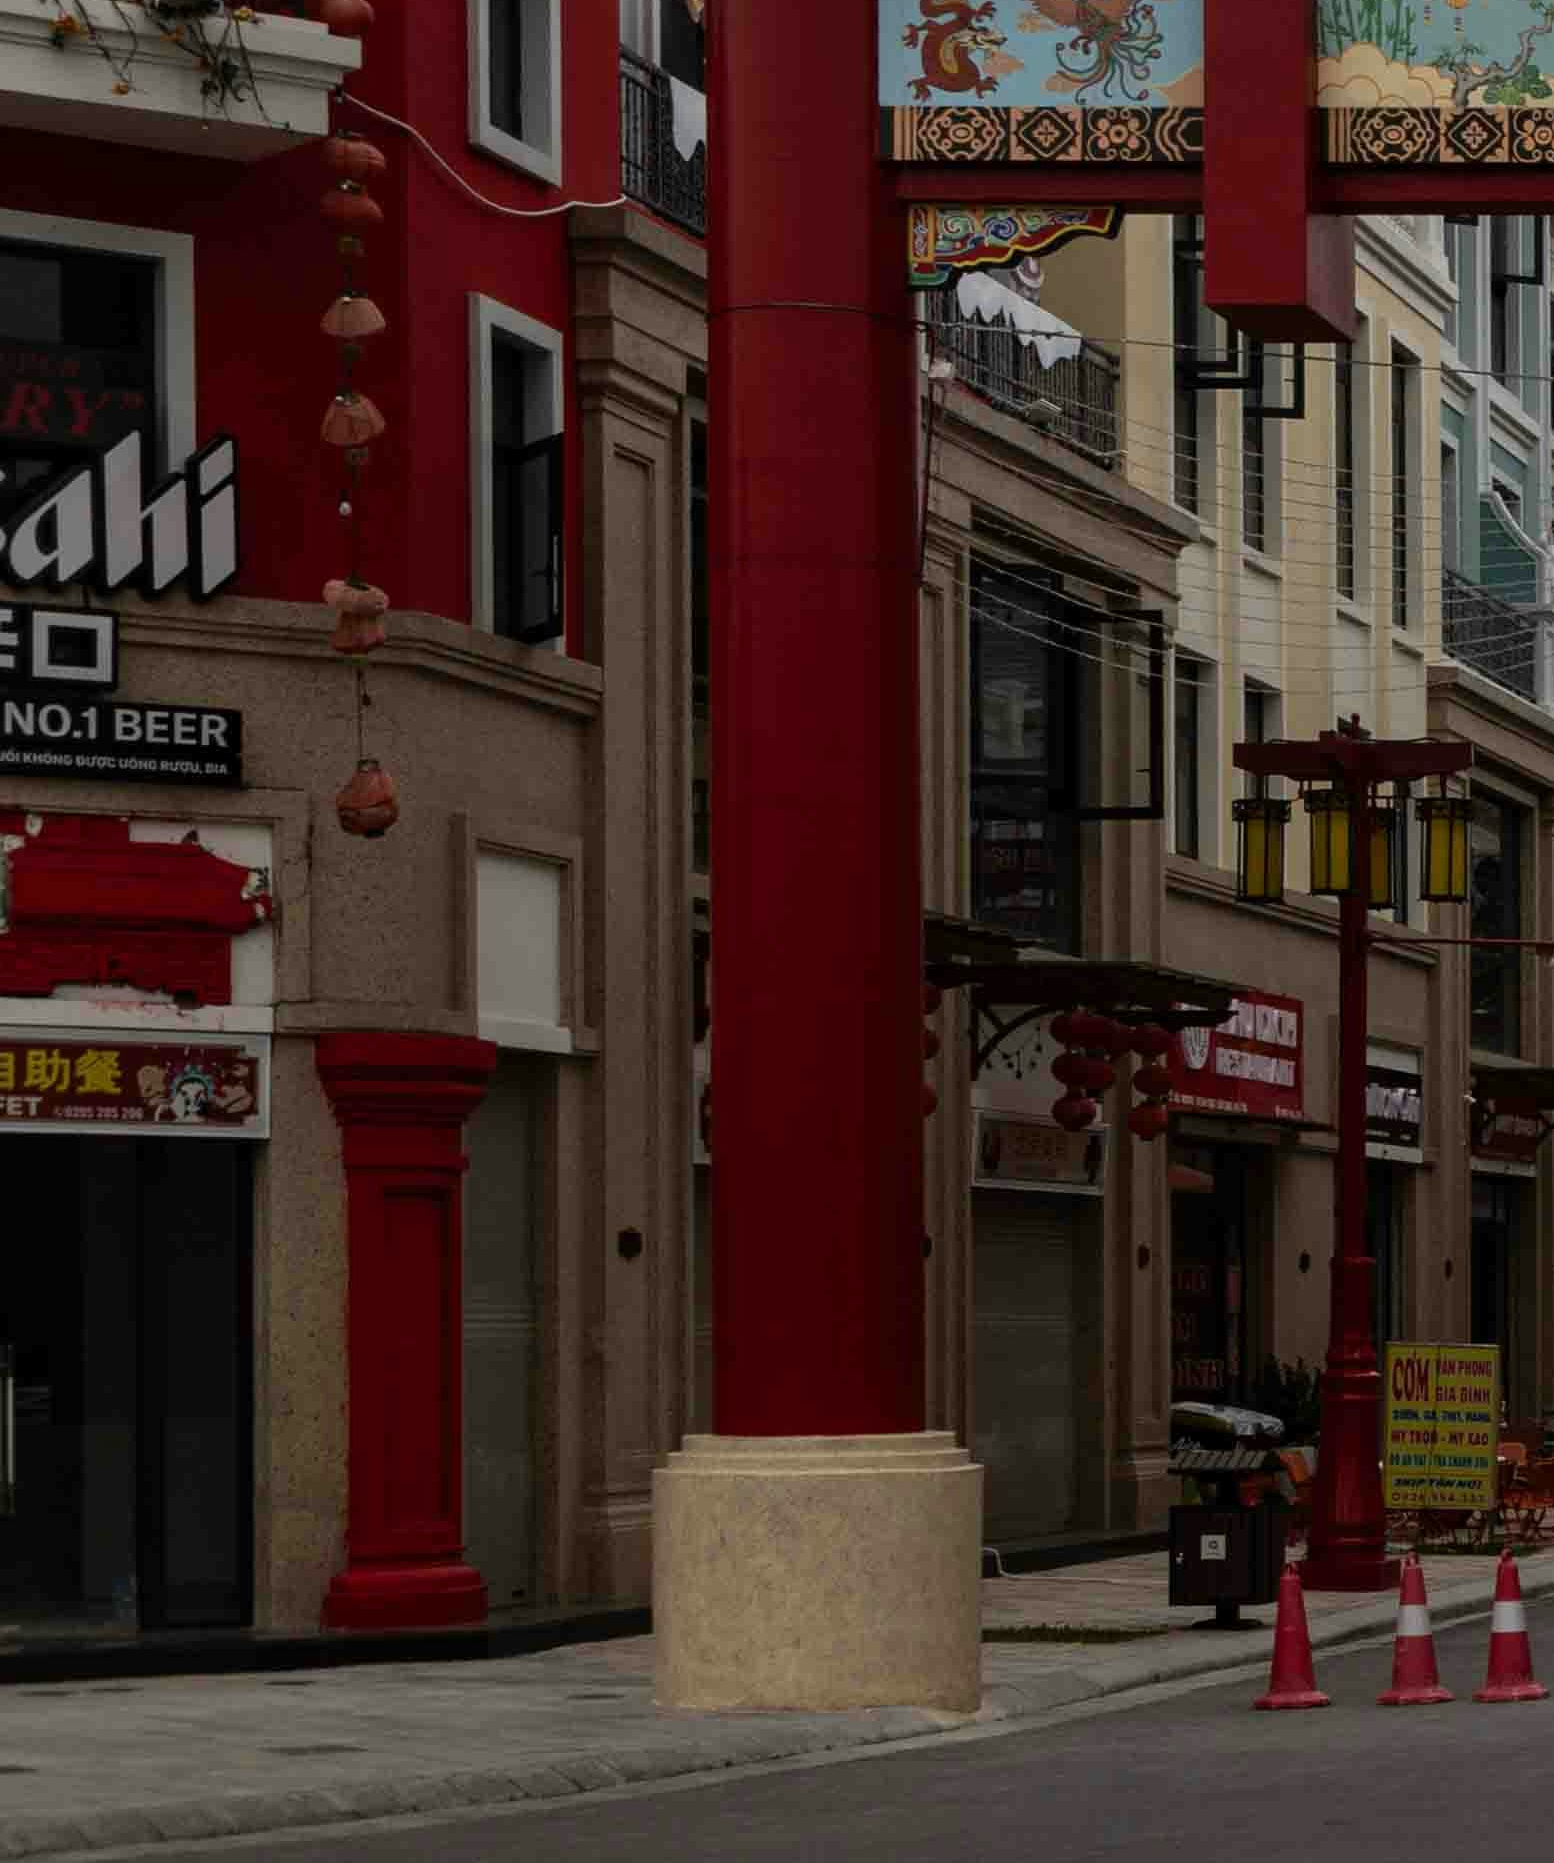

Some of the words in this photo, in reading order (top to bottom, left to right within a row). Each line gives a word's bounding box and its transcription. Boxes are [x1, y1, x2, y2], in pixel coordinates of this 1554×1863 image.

[0, 428, 239, 597] ahi
[2, 700, 98, 741] NO.1
[112, 707, 230, 748] BEER
